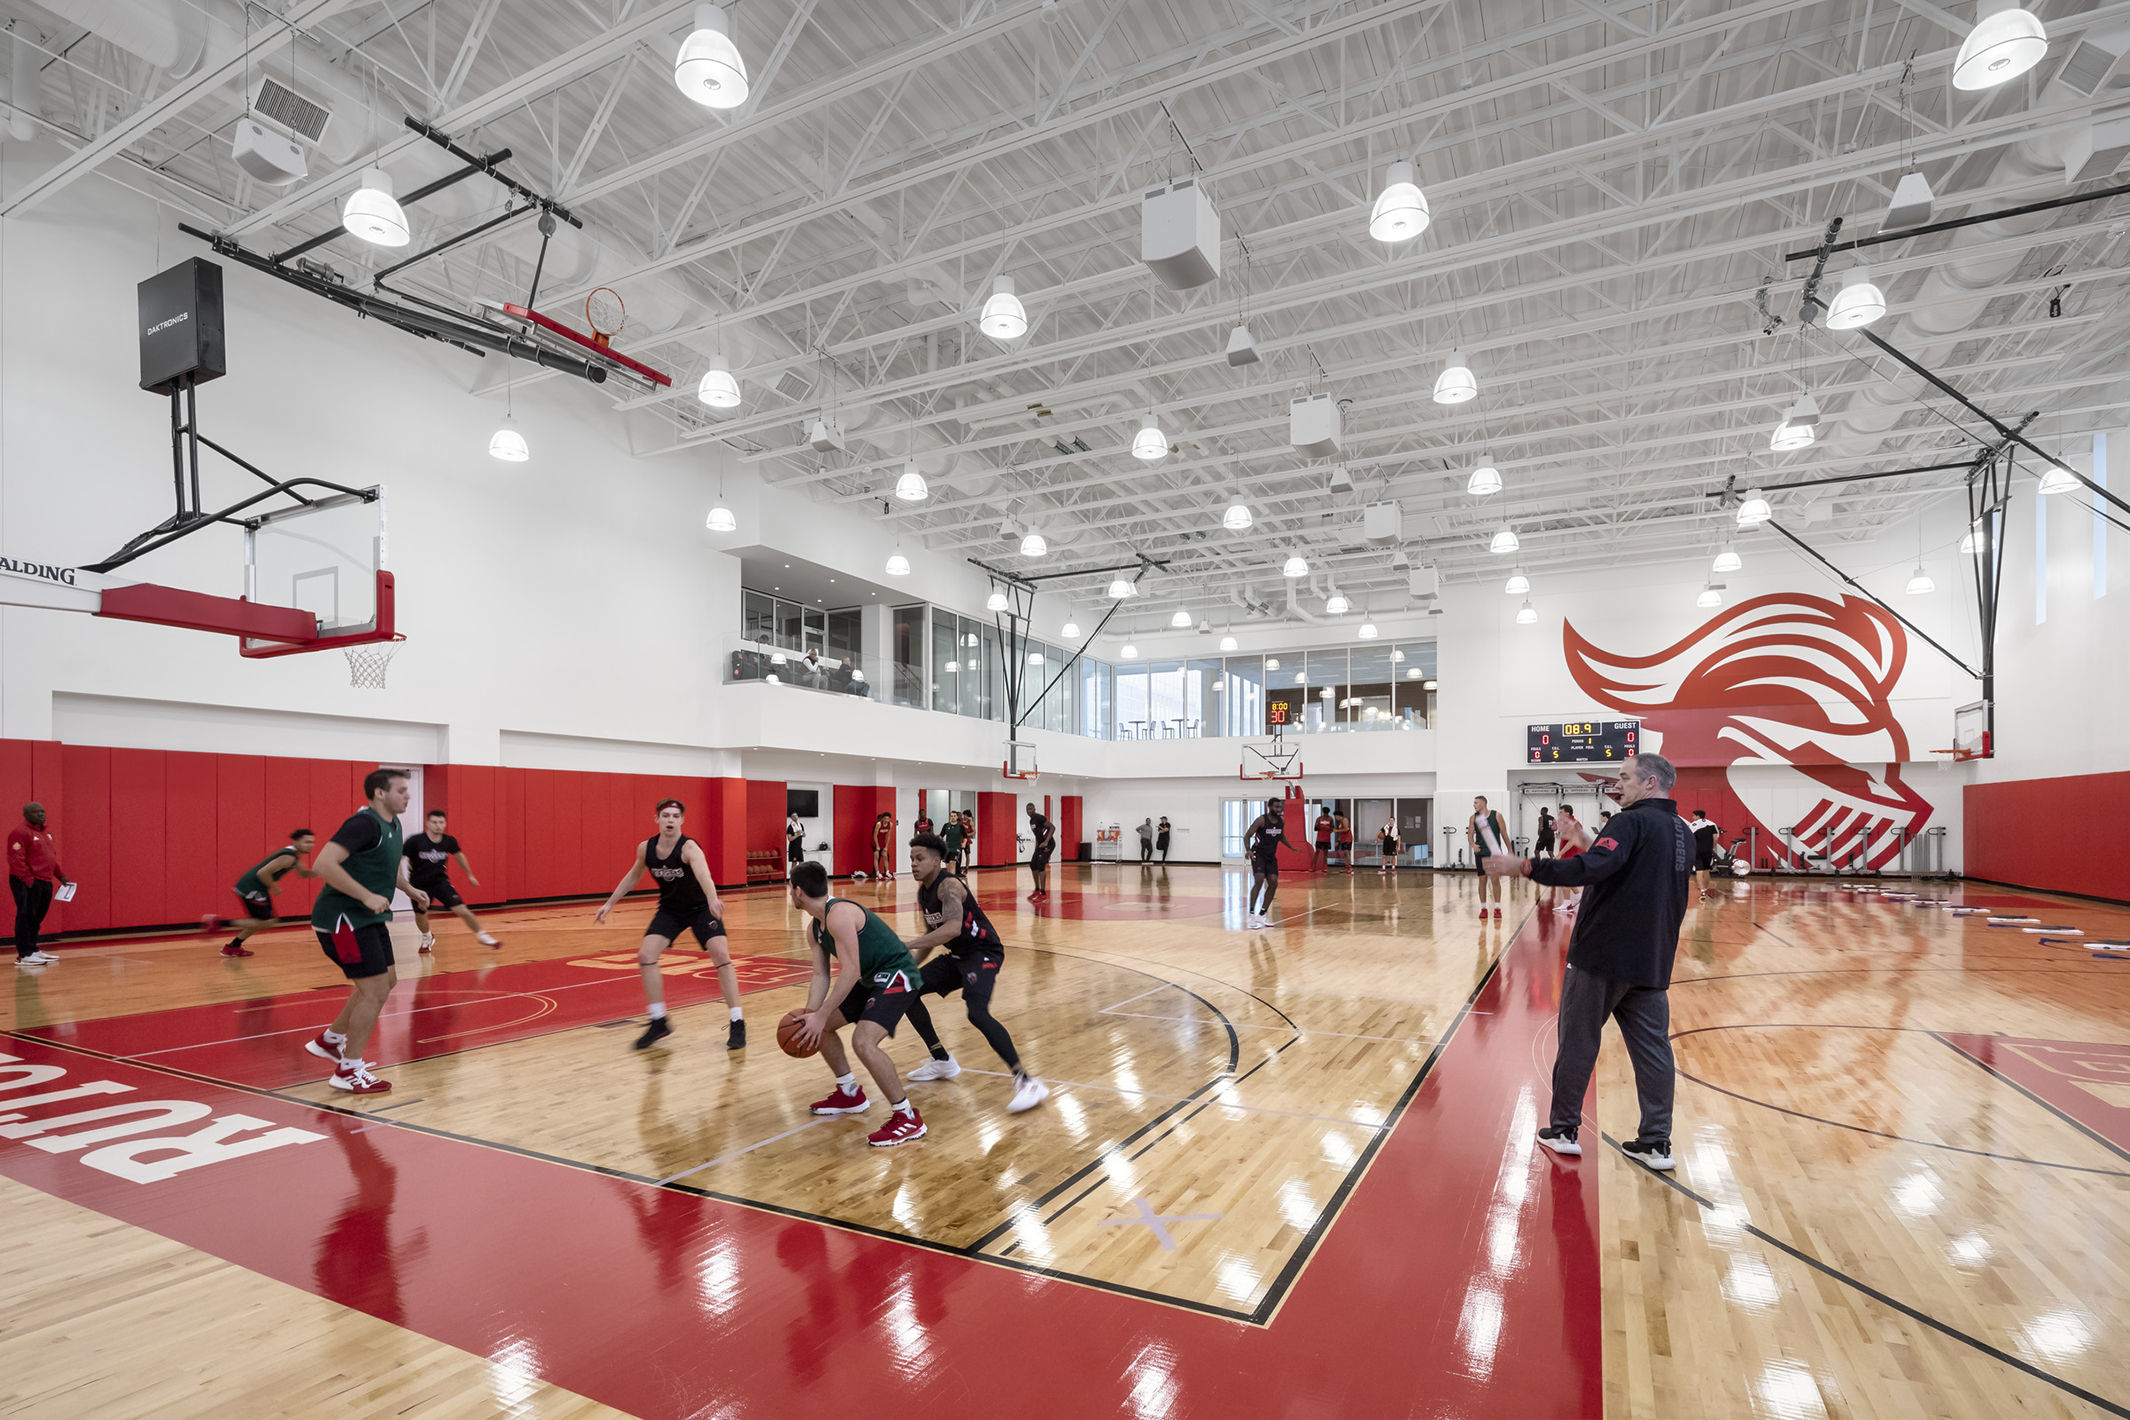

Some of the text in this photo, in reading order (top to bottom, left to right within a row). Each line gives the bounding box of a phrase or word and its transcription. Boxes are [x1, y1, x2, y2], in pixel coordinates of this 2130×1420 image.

[147, 312, 188, 336] DAKTRONICS
[1271, 710, 1285, 723] 30
[1565, 723, 1592, 735] 08.9
[1614, 722, 1636, 730] GUEST
[1541, 734, 1550, 745] 0
[1627, 731, 1635, 743] 0
[1534, 750, 1541, 759] 0
[1627, 748, 1635, 757] 0
[1672, 816, 1686, 872] RUTGERS
